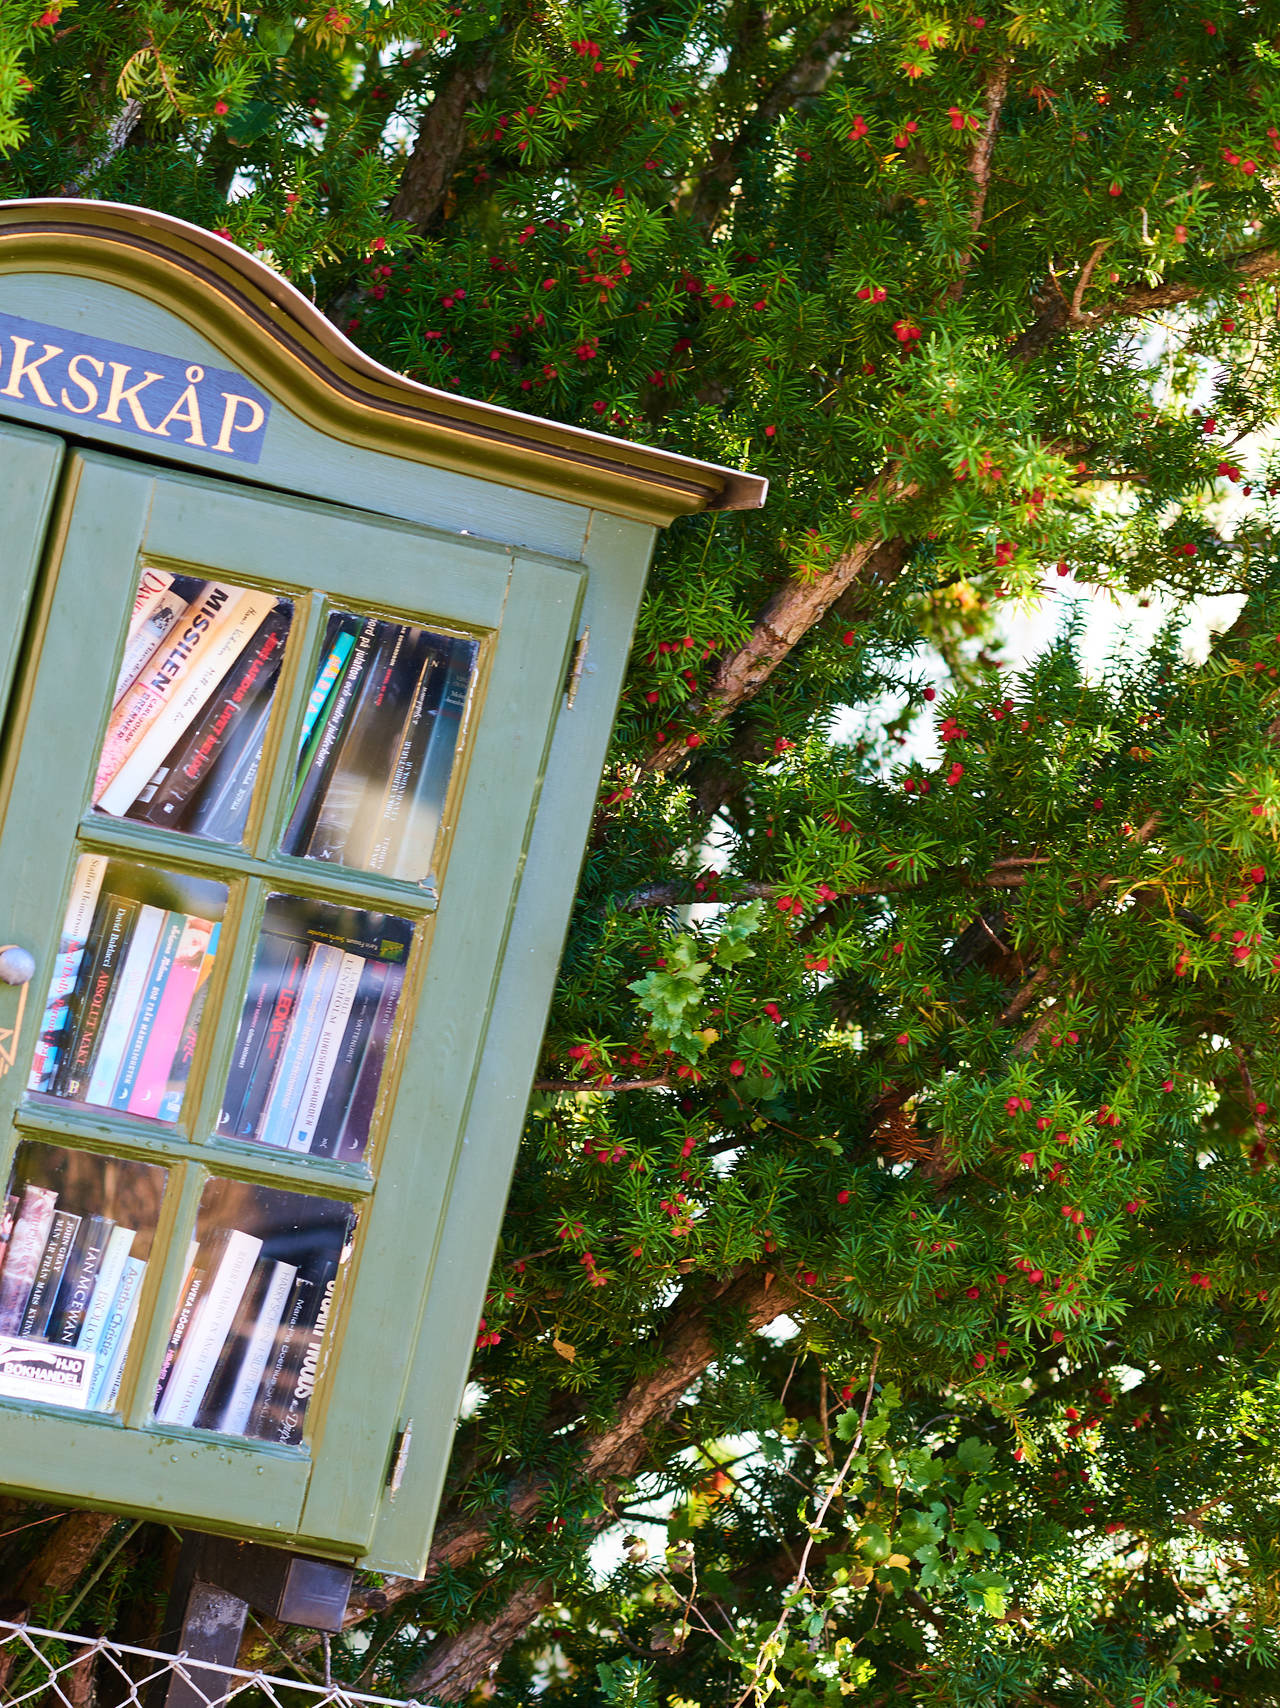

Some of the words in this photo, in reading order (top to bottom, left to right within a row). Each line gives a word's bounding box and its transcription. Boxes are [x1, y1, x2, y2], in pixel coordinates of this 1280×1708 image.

[149, 586, 230, 693] MISSILEN
[256, 630, 281, 661] JENS
[355, 635, 373, 650] på
[230, 657, 264, 703] LAPIDUS
[344, 647, 368, 681] julafton
[340, 680, 355, 698] och
[114, 691, 151, 739] BRENNER
[210, 703, 235, 735] LIVET
[329, 695, 349, 724] andra
[313, 720, 340, 768] juldeckare
[83, 857, 101, 889] Staffan
[70, 889, 91, 937] Heimerson
[110, 906, 127, 932] David
[101, 932, 119, 968] Baldacci
[53, 965, 73, 996] Dolly
[45, 997, 65, 1033] Parton
[83, 969, 110, 1029] ABSOLUT
[141, 1000, 157, 1023] FRÅN
[268, 987, 294, 1035] LEONA
[74, 1029, 93, 1067] MAKT
[50, 1217, 65, 1239] MÄN
[60, 1219, 75, 1246] JOHN
[46, 1239, 59, 1254] ÄR
[51, 1245, 67, 1272] GRAY
[81, 1245, 101, 1274] IAN
[38, 1254, 54, 1280] FRÅN
[30, 1280, 45, 1306] MARS
[113, 1265, 139, 1311] Agatha
[182, 1278, 202, 1307] VIVEKA
[20, 1307, 37, 1339] KVINN
[97, 1311, 124, 1357] Christie
[169, 1307, 191, 1345] SJÖGREN
[4, 1361, 83, 1387] BOKHANDEL
[55, 1355, 83, 1374] HJO
[291, 1341, 322, 1401] WOODS
